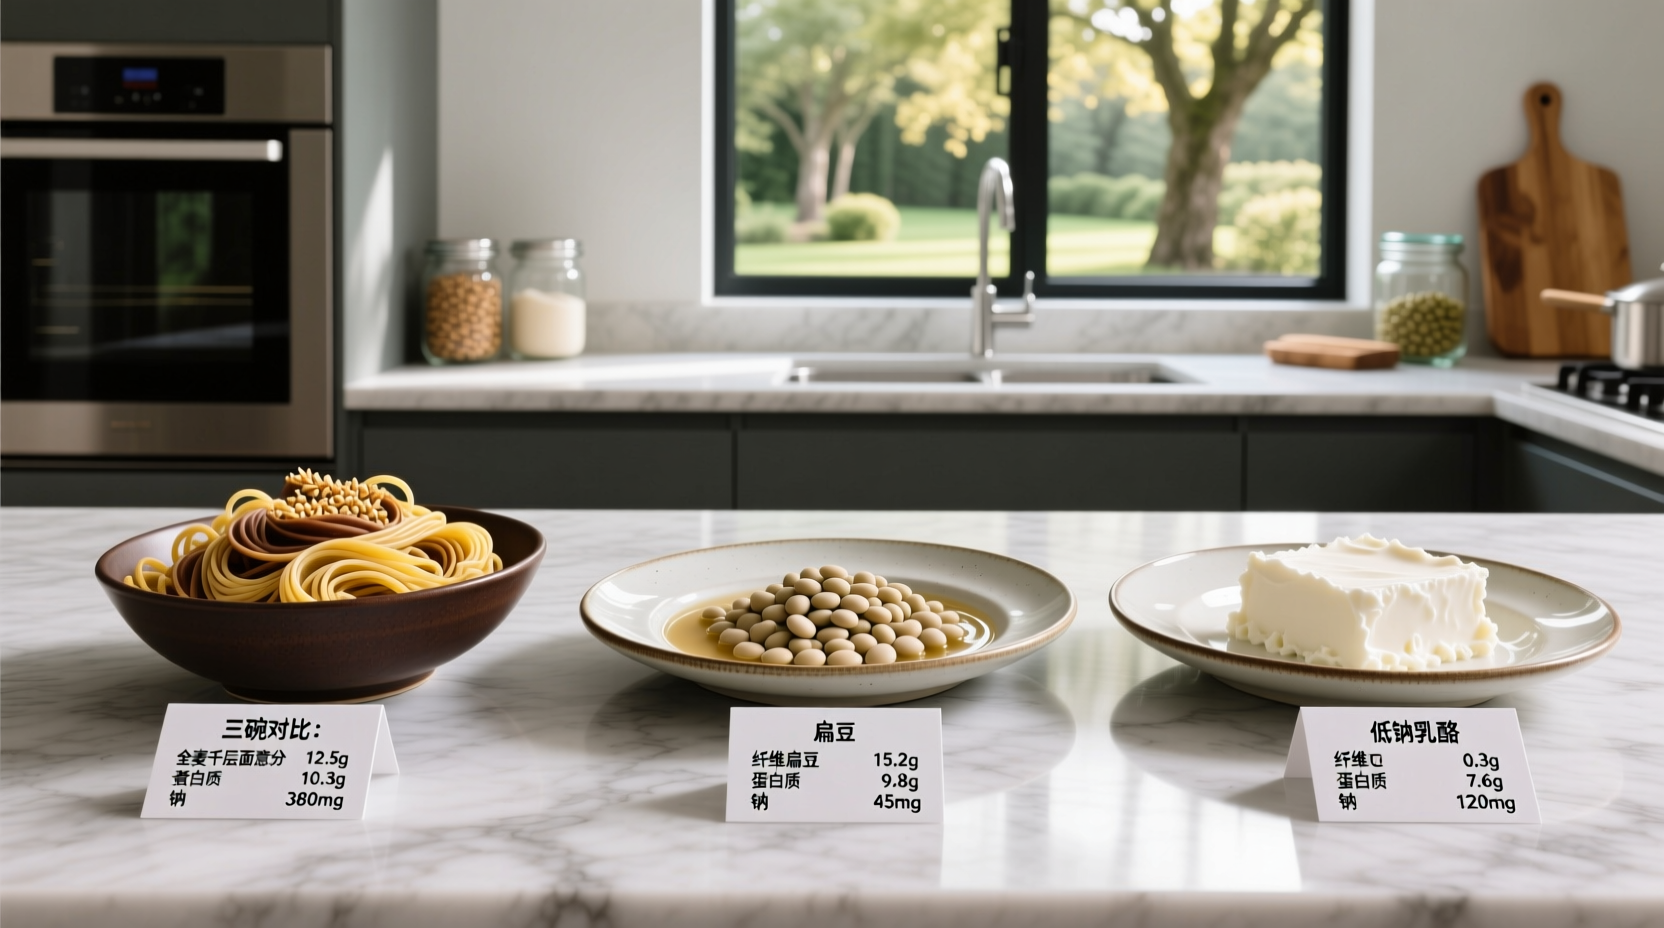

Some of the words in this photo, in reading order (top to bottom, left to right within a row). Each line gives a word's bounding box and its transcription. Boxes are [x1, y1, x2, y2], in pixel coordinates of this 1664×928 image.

[813, 720, 856, 742] 扁豆
[1369, 720, 1461, 744] 低钠乳酪
[306, 751, 349, 769] 12.5g
[751, 750, 820, 768] 纤维扁豆
[873, 752, 919, 771] 15.2g
[1462, 753, 1500, 771] 0.3g
[301, 771, 346, 789] 10.3g
[751, 772, 801, 789] 蛋白质
[881, 773, 919, 792] 9.8g
[1336, 771, 1387, 789] 蛋白质
[1465, 773, 1504, 792] 7.6g
[169, 789, 187, 807] 钠
[284, 792, 344, 810] 380mg
[873, 794, 922, 813] 45mg
[1456, 794, 1516, 813] 120mg
